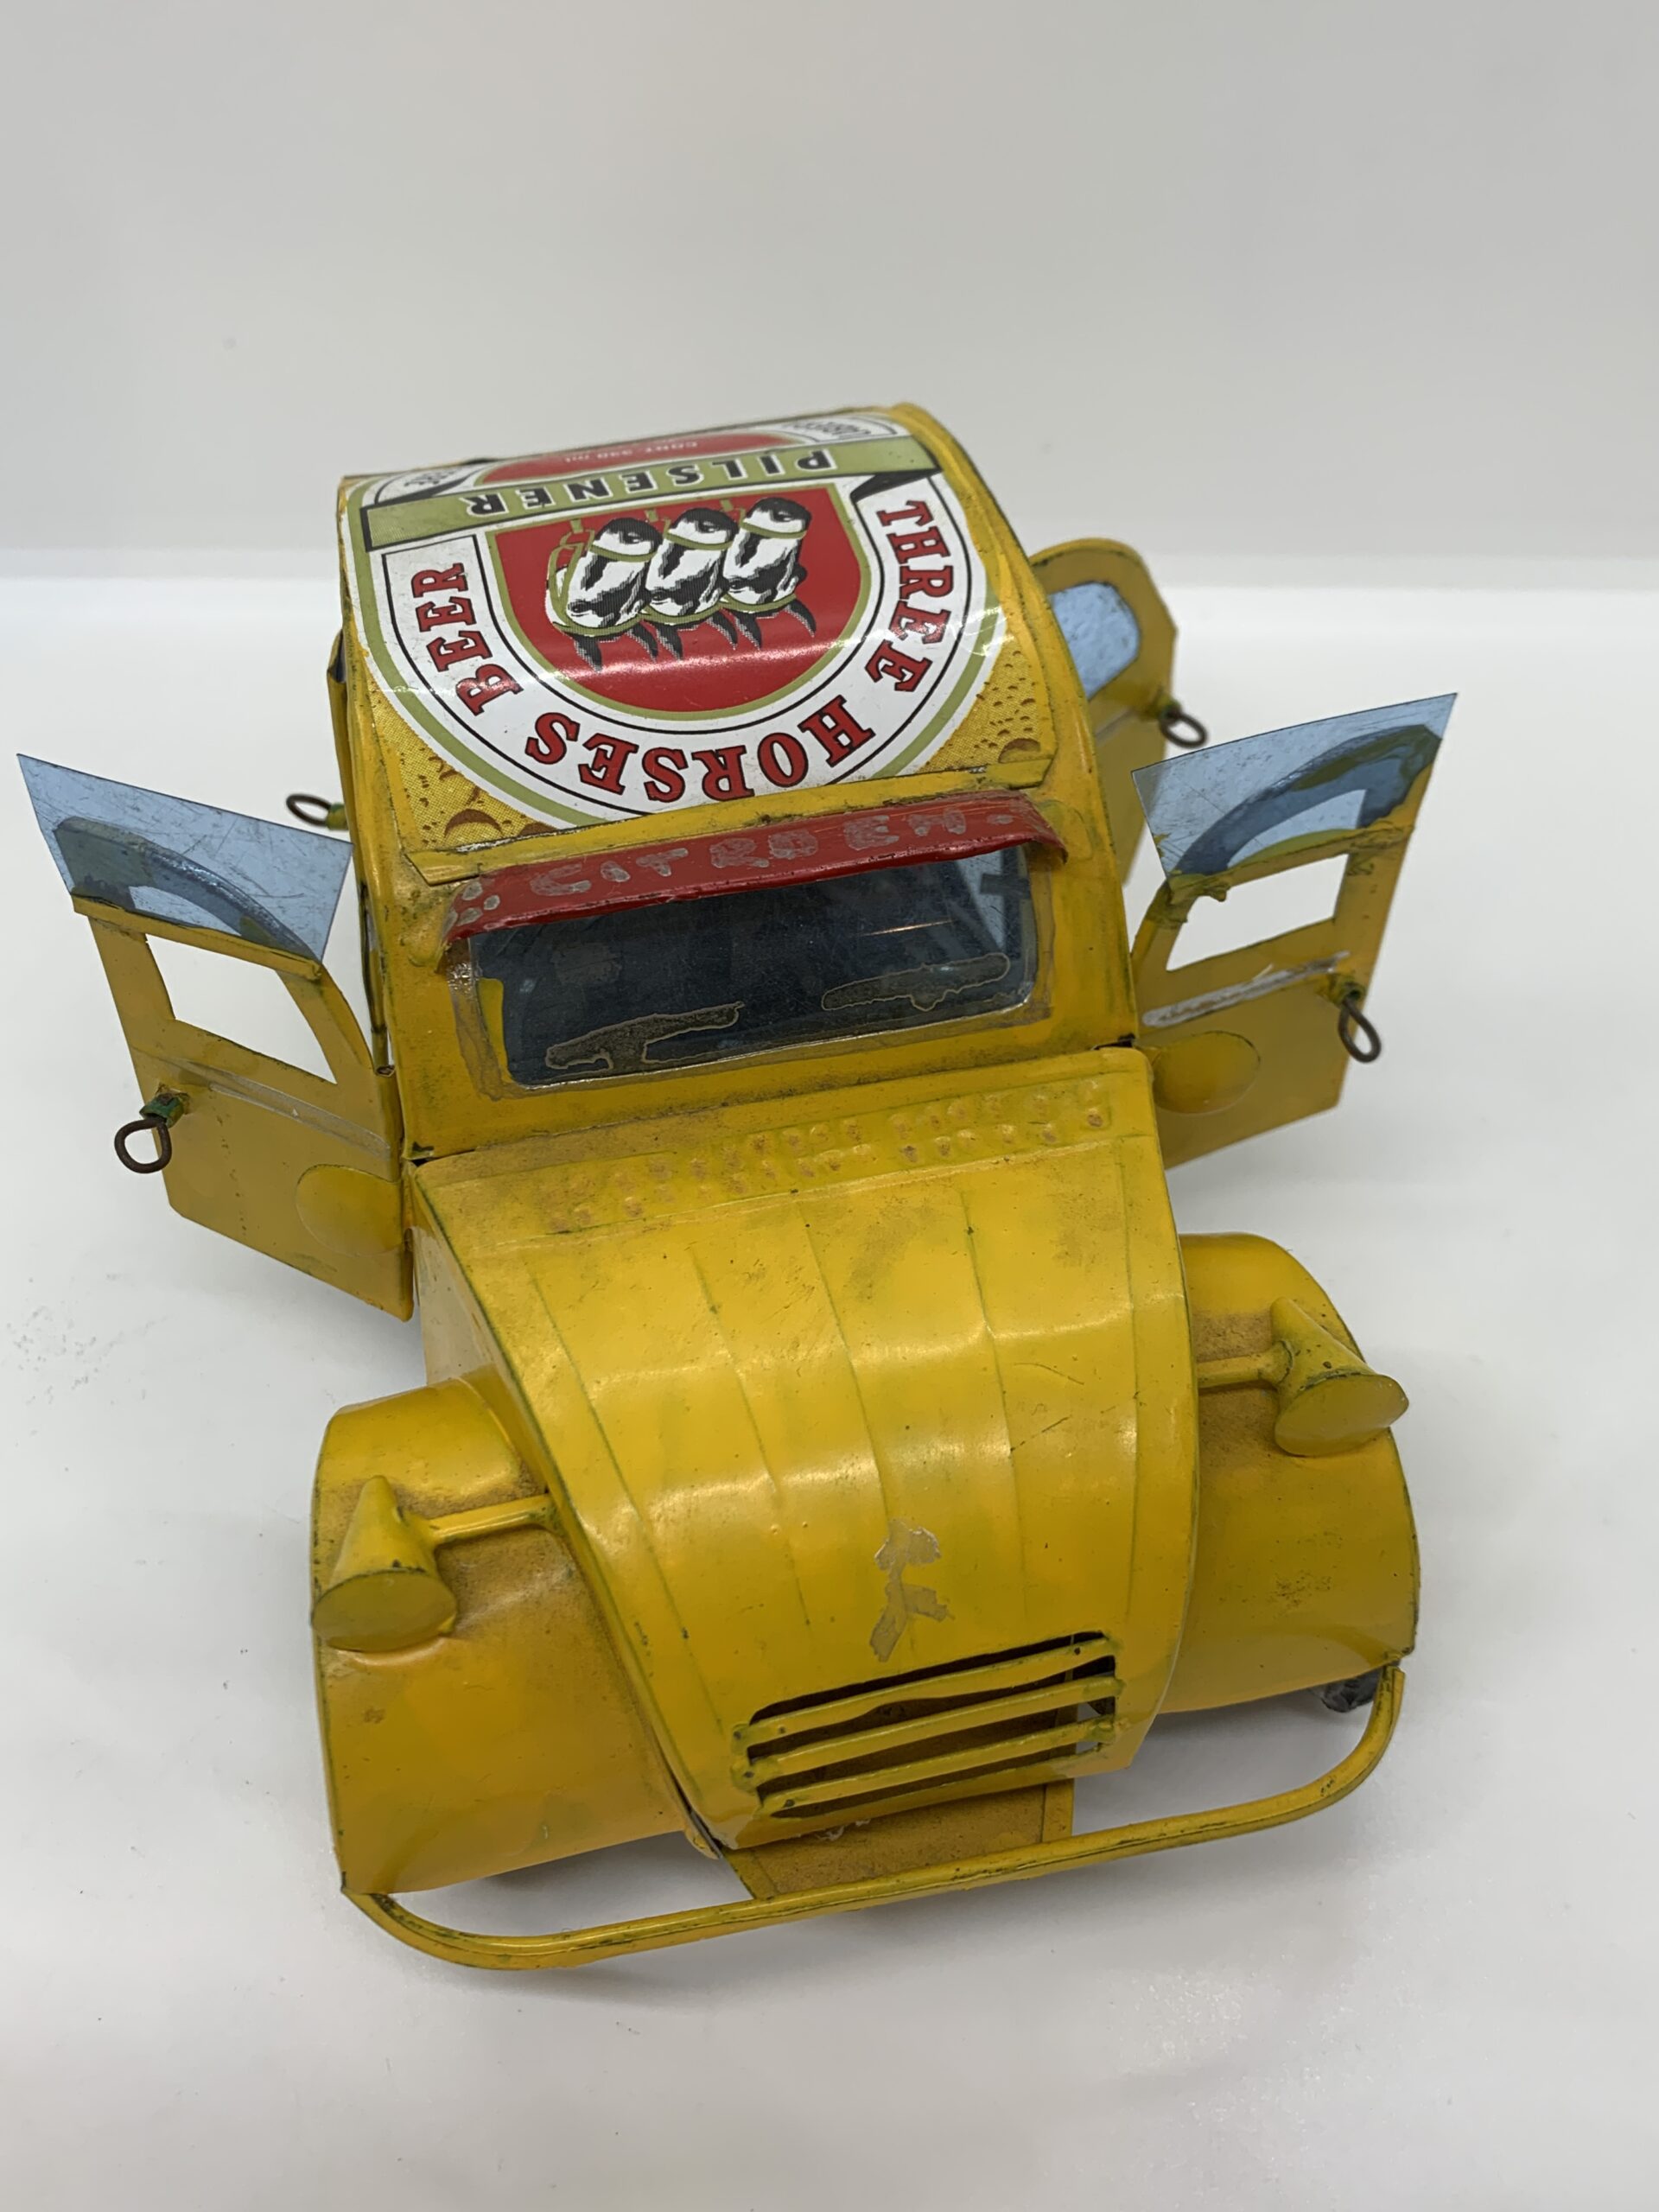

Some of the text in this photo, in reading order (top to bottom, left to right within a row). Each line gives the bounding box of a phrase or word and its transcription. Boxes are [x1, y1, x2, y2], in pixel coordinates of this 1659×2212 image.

[463, 448, 835, 516] PILSENER
[410, 499, 955, 804] THREE HORSES BEER
